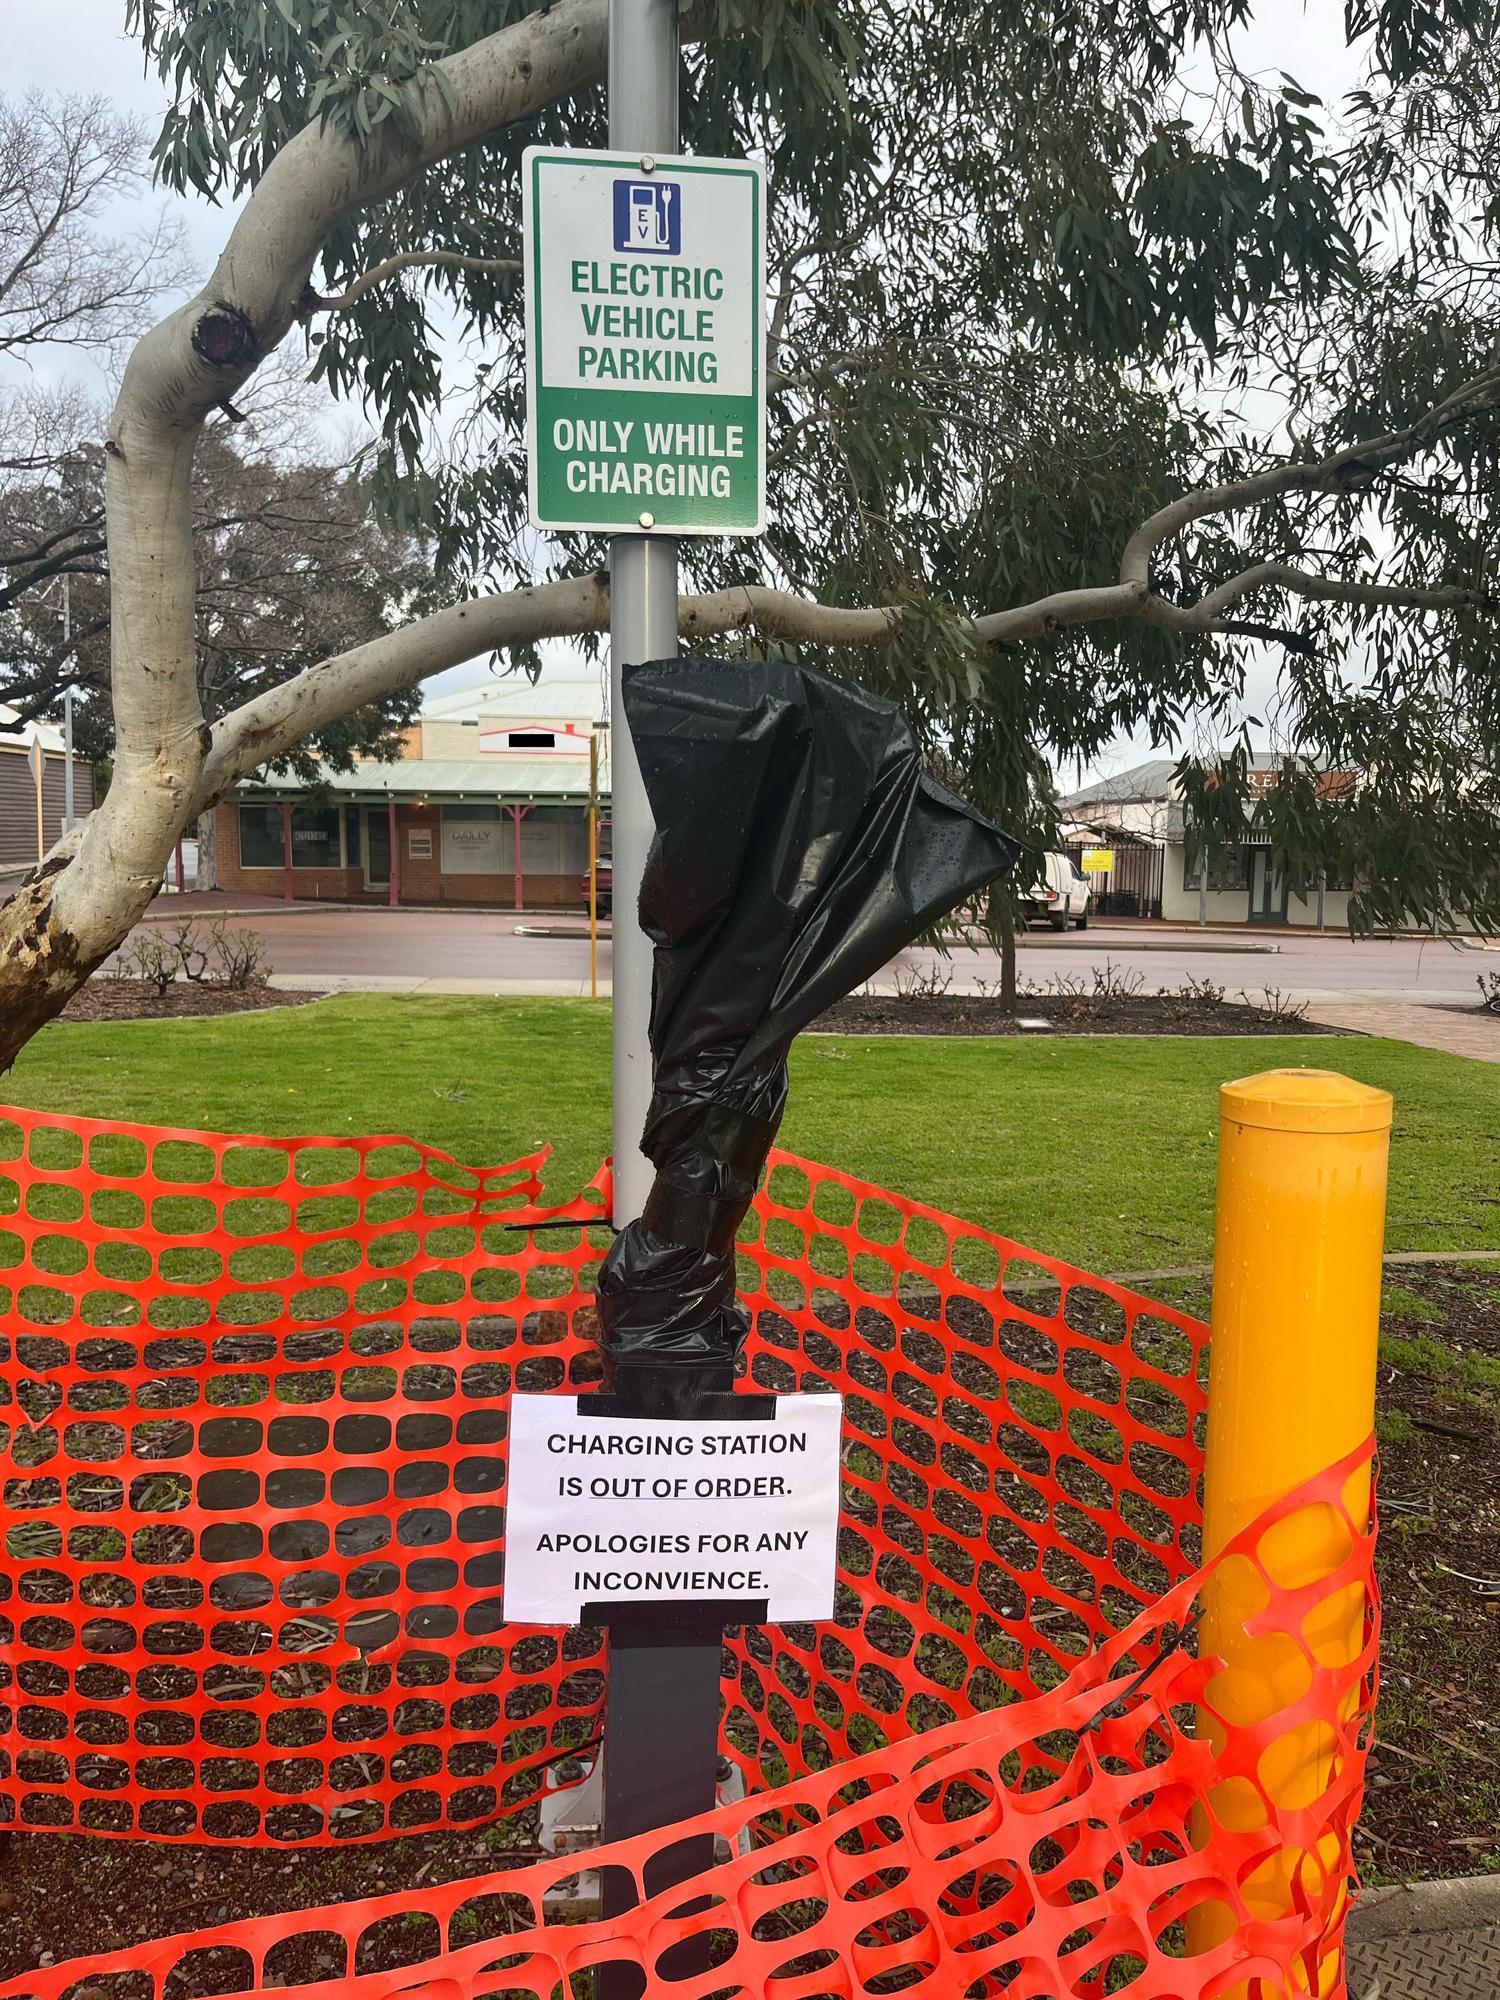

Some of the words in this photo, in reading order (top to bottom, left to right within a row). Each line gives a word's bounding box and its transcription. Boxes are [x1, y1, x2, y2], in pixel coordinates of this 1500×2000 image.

[638, 209, 649, 239] EV
[571, 260, 724, 300] ELECTRIC
[580, 304, 714, 342] VEHICLE
[578, 346, 718, 383] PARKING
[552, 418, 634, 454] ONLY
[644, 422, 744, 458] WHILE
[566, 460, 732, 498] CHARGING
[547, 1433, 694, 1456] CHARGING
[701, 1432, 807, 1455] STATION
[558, 1477, 583, 1496] IS
[590, 1478, 646, 1498] OUT
[652, 1478, 688, 1498] OF
[694, 1476, 793, 1497] ORDER.
[536, 1533, 691, 1553] APOLOGIES
[698, 1533, 750, 1553] FOR
[755, 1530, 809, 1552] ANY
[574, 1571, 770, 1590] INCONVIENCE.
